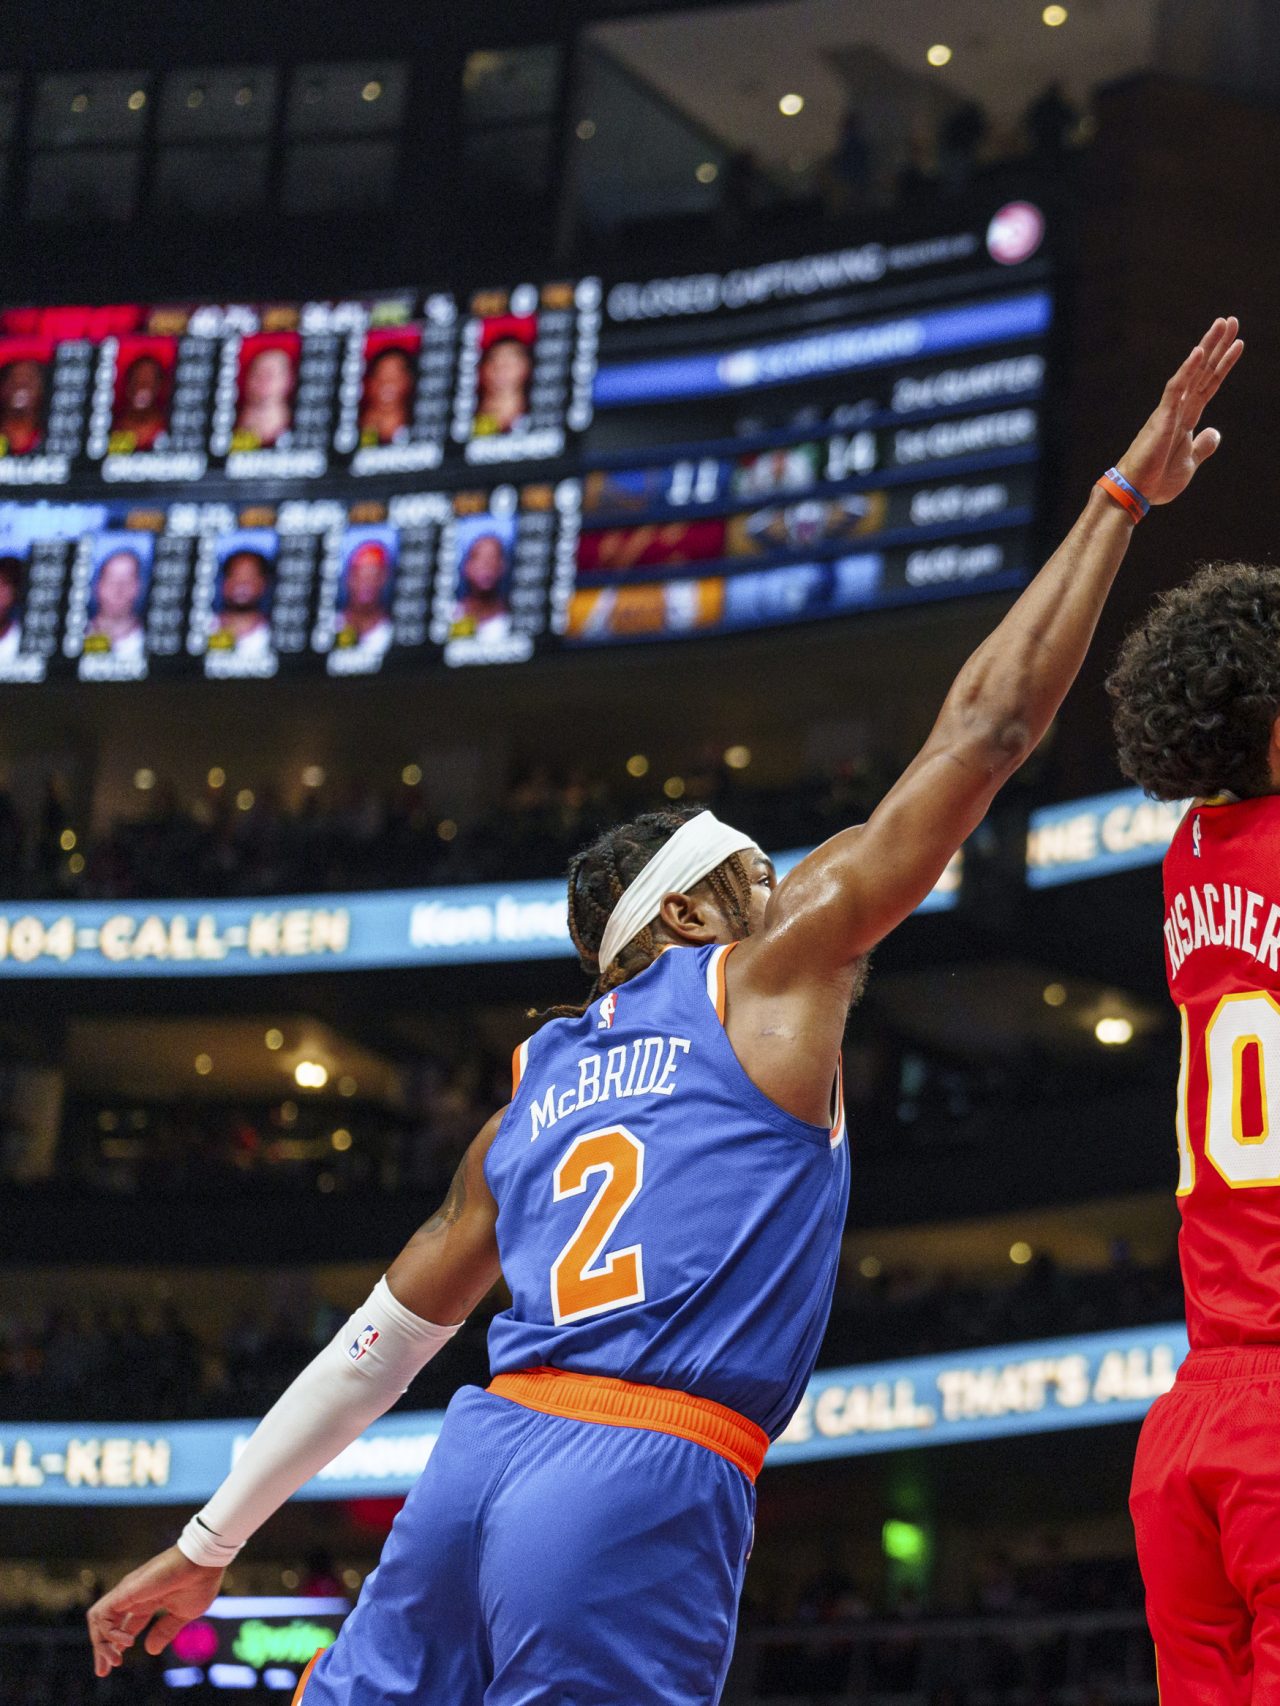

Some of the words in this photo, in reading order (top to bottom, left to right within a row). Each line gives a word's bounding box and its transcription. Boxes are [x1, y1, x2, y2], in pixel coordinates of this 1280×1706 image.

[0, 908, 351, 962] 04-CALL-KEN
[530, 1037, 691, 1143] McBRIDE
[550, 1124, 646, 1327] 2
[936, 1353, 1090, 1422] THAT'S
